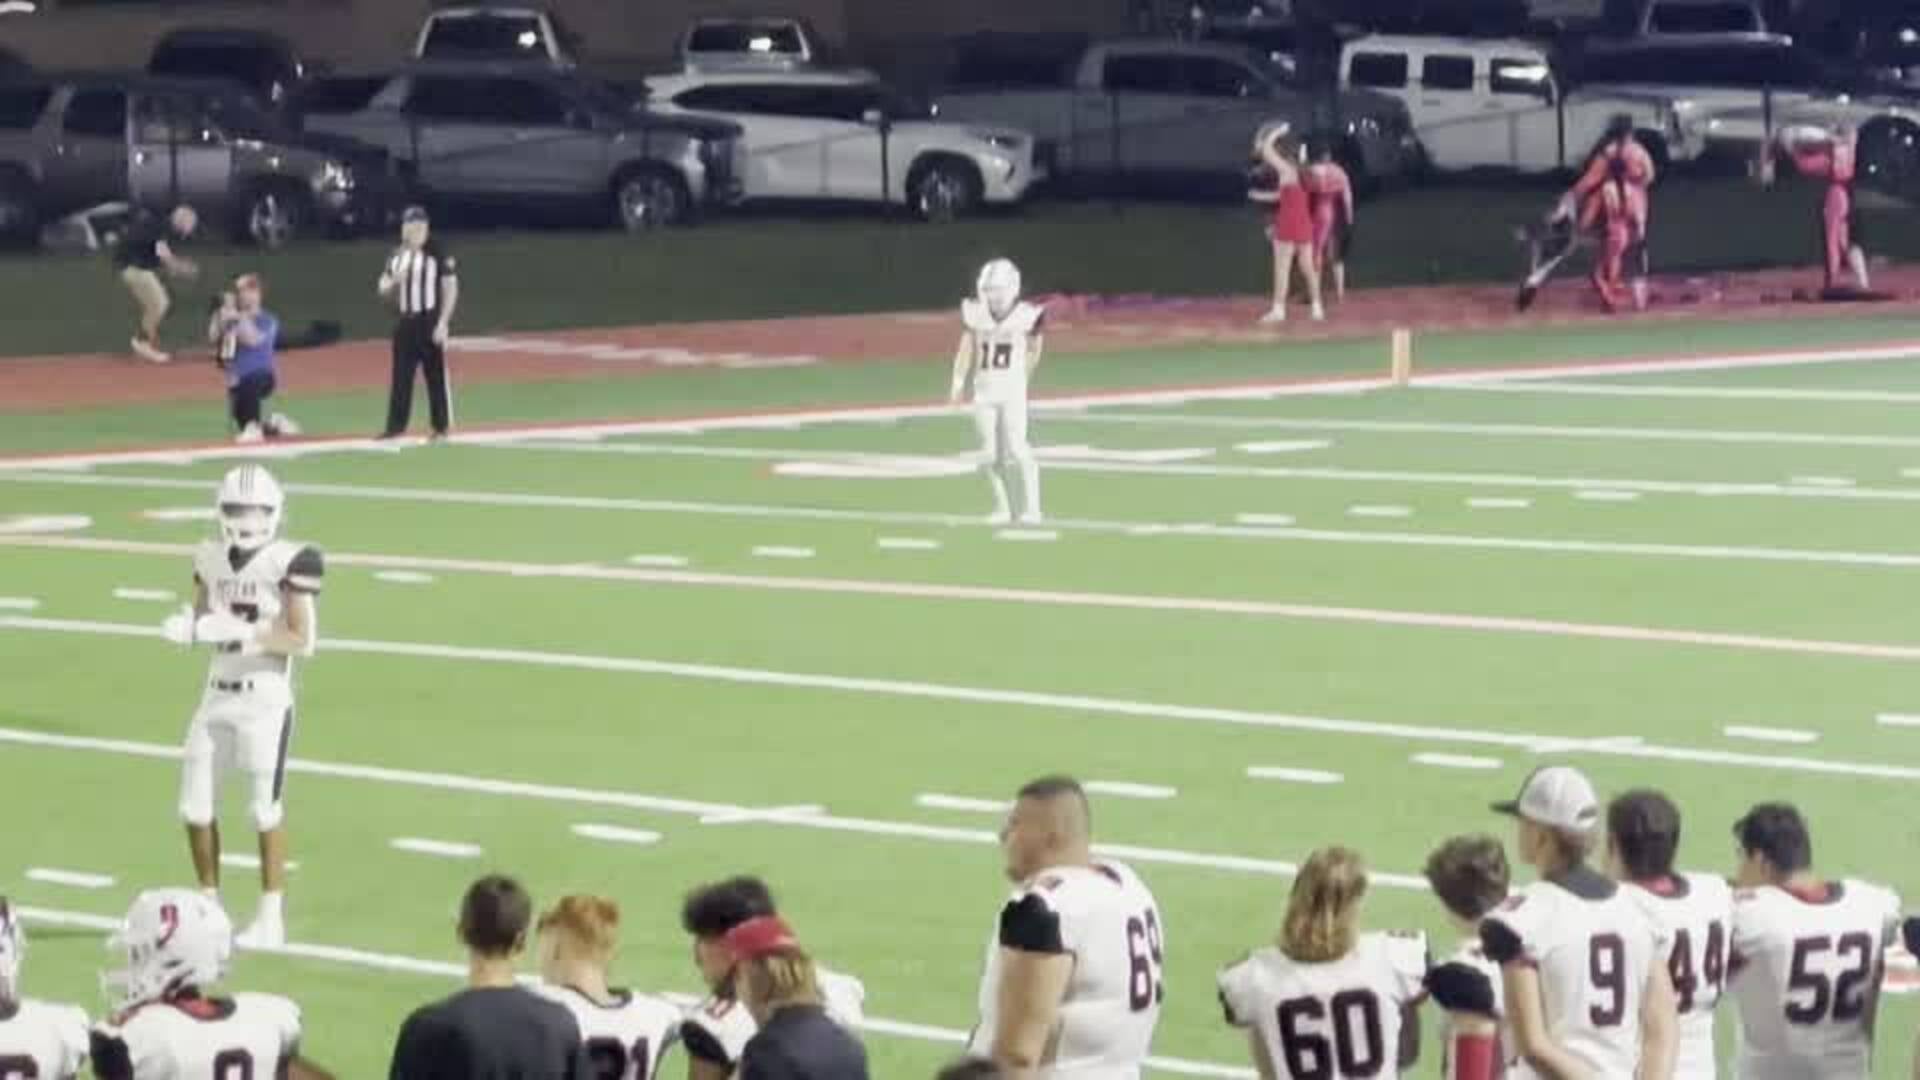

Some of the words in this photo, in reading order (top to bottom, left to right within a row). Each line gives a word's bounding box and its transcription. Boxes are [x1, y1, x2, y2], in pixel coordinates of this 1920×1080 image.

[1589, 932, 1625, 1027] 9
[1668, 920, 1723, 1014] 44
[1785, 932, 1872, 1024] 52
[1276, 988, 1384, 1080] 60
